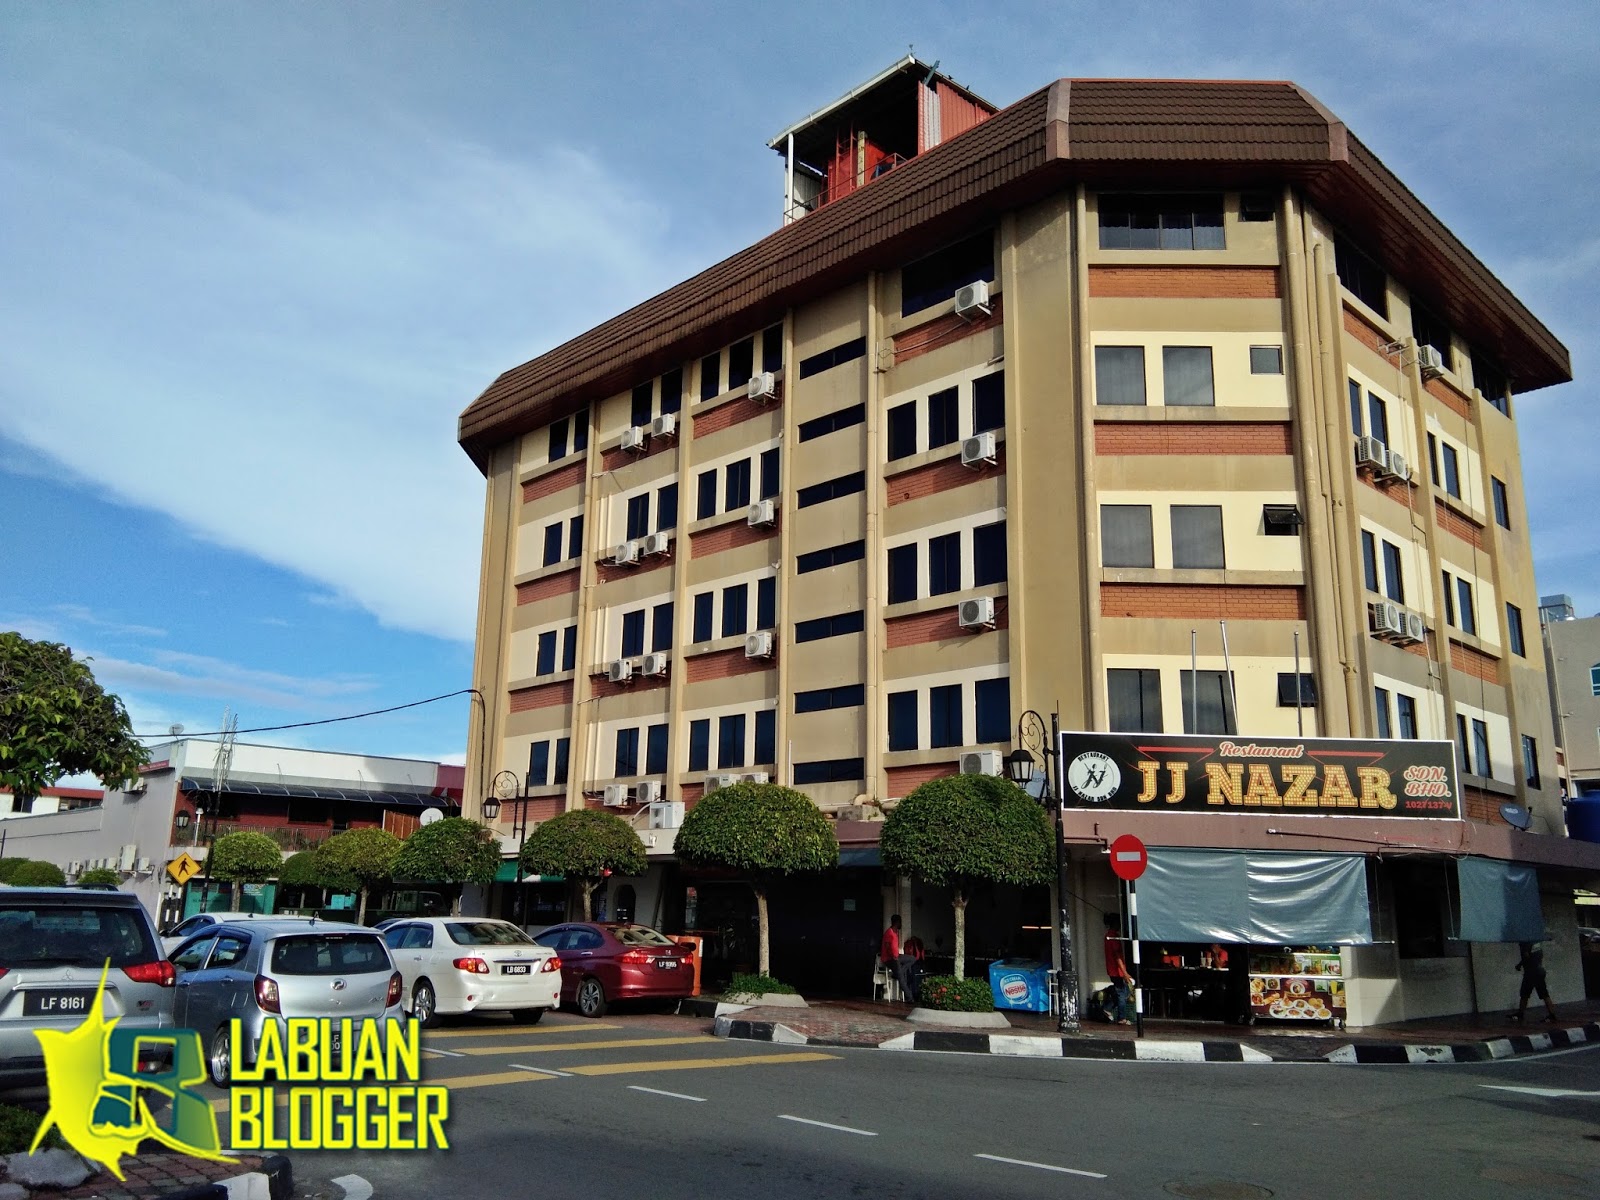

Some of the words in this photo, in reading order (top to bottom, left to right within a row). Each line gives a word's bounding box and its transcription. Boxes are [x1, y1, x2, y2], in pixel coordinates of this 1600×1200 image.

[1220, 741, 1304, 758] Restaurant
[1403, 765, 1448, 782] SDN.
[1137, 760, 1189, 804] JJ
[1205, 762, 1398, 810] NAZAR
[1404, 781, 1452, 797] BHD.
[41, 998, 57, 1010] LF
[60, 997, 85, 1010] 8161
